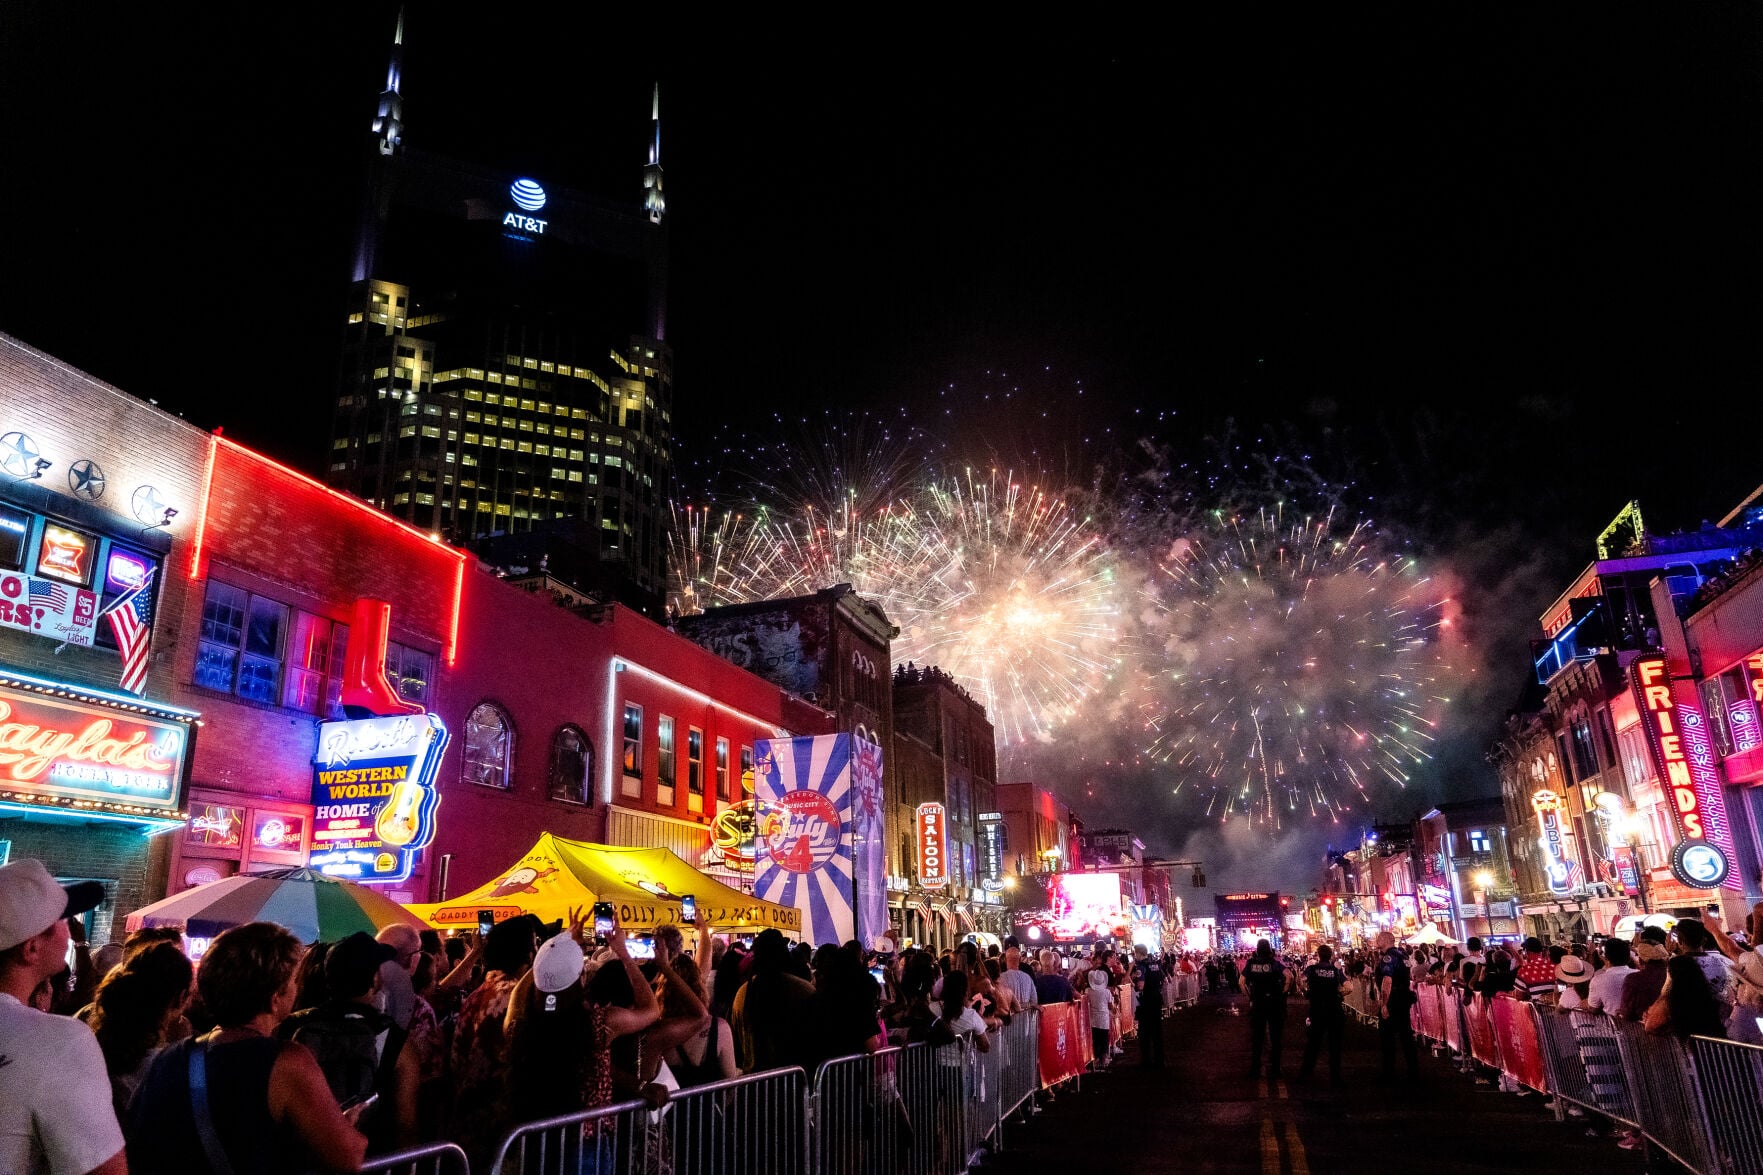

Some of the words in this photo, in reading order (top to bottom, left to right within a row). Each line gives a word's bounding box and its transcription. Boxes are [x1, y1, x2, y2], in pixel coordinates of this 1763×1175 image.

[503, 212, 548, 234] AT&T
[78, 595, 93, 618] $5
[67, 632, 90, 645] LIGHT
[1638, 660, 1703, 839] FRIENDS
[318, 765, 408, 785] WESTERN
[329, 782, 394, 800] WORLD
[316, 803, 371, 820] HOME
[371, 800, 385, 818] of
[1700, 771, 1723, 840] PLACES
[769, 812, 829, 848] July
[311, 841, 334, 852] Honky
[335, 840, 355, 849] Tonk
[355, 839, 382, 848] Heaven
[787, 834, 814, 874] 4
[924, 815, 939, 877] SALOON
[986, 824, 997, 880] WHISKEY
[1620, 870, 1634, 879] 250
[494, 910, 515, 918] OGS
[620, 904, 661, 925] OLLY,
[730, 905, 767, 921] TASTY
[772, 908, 798, 926] DOG!
